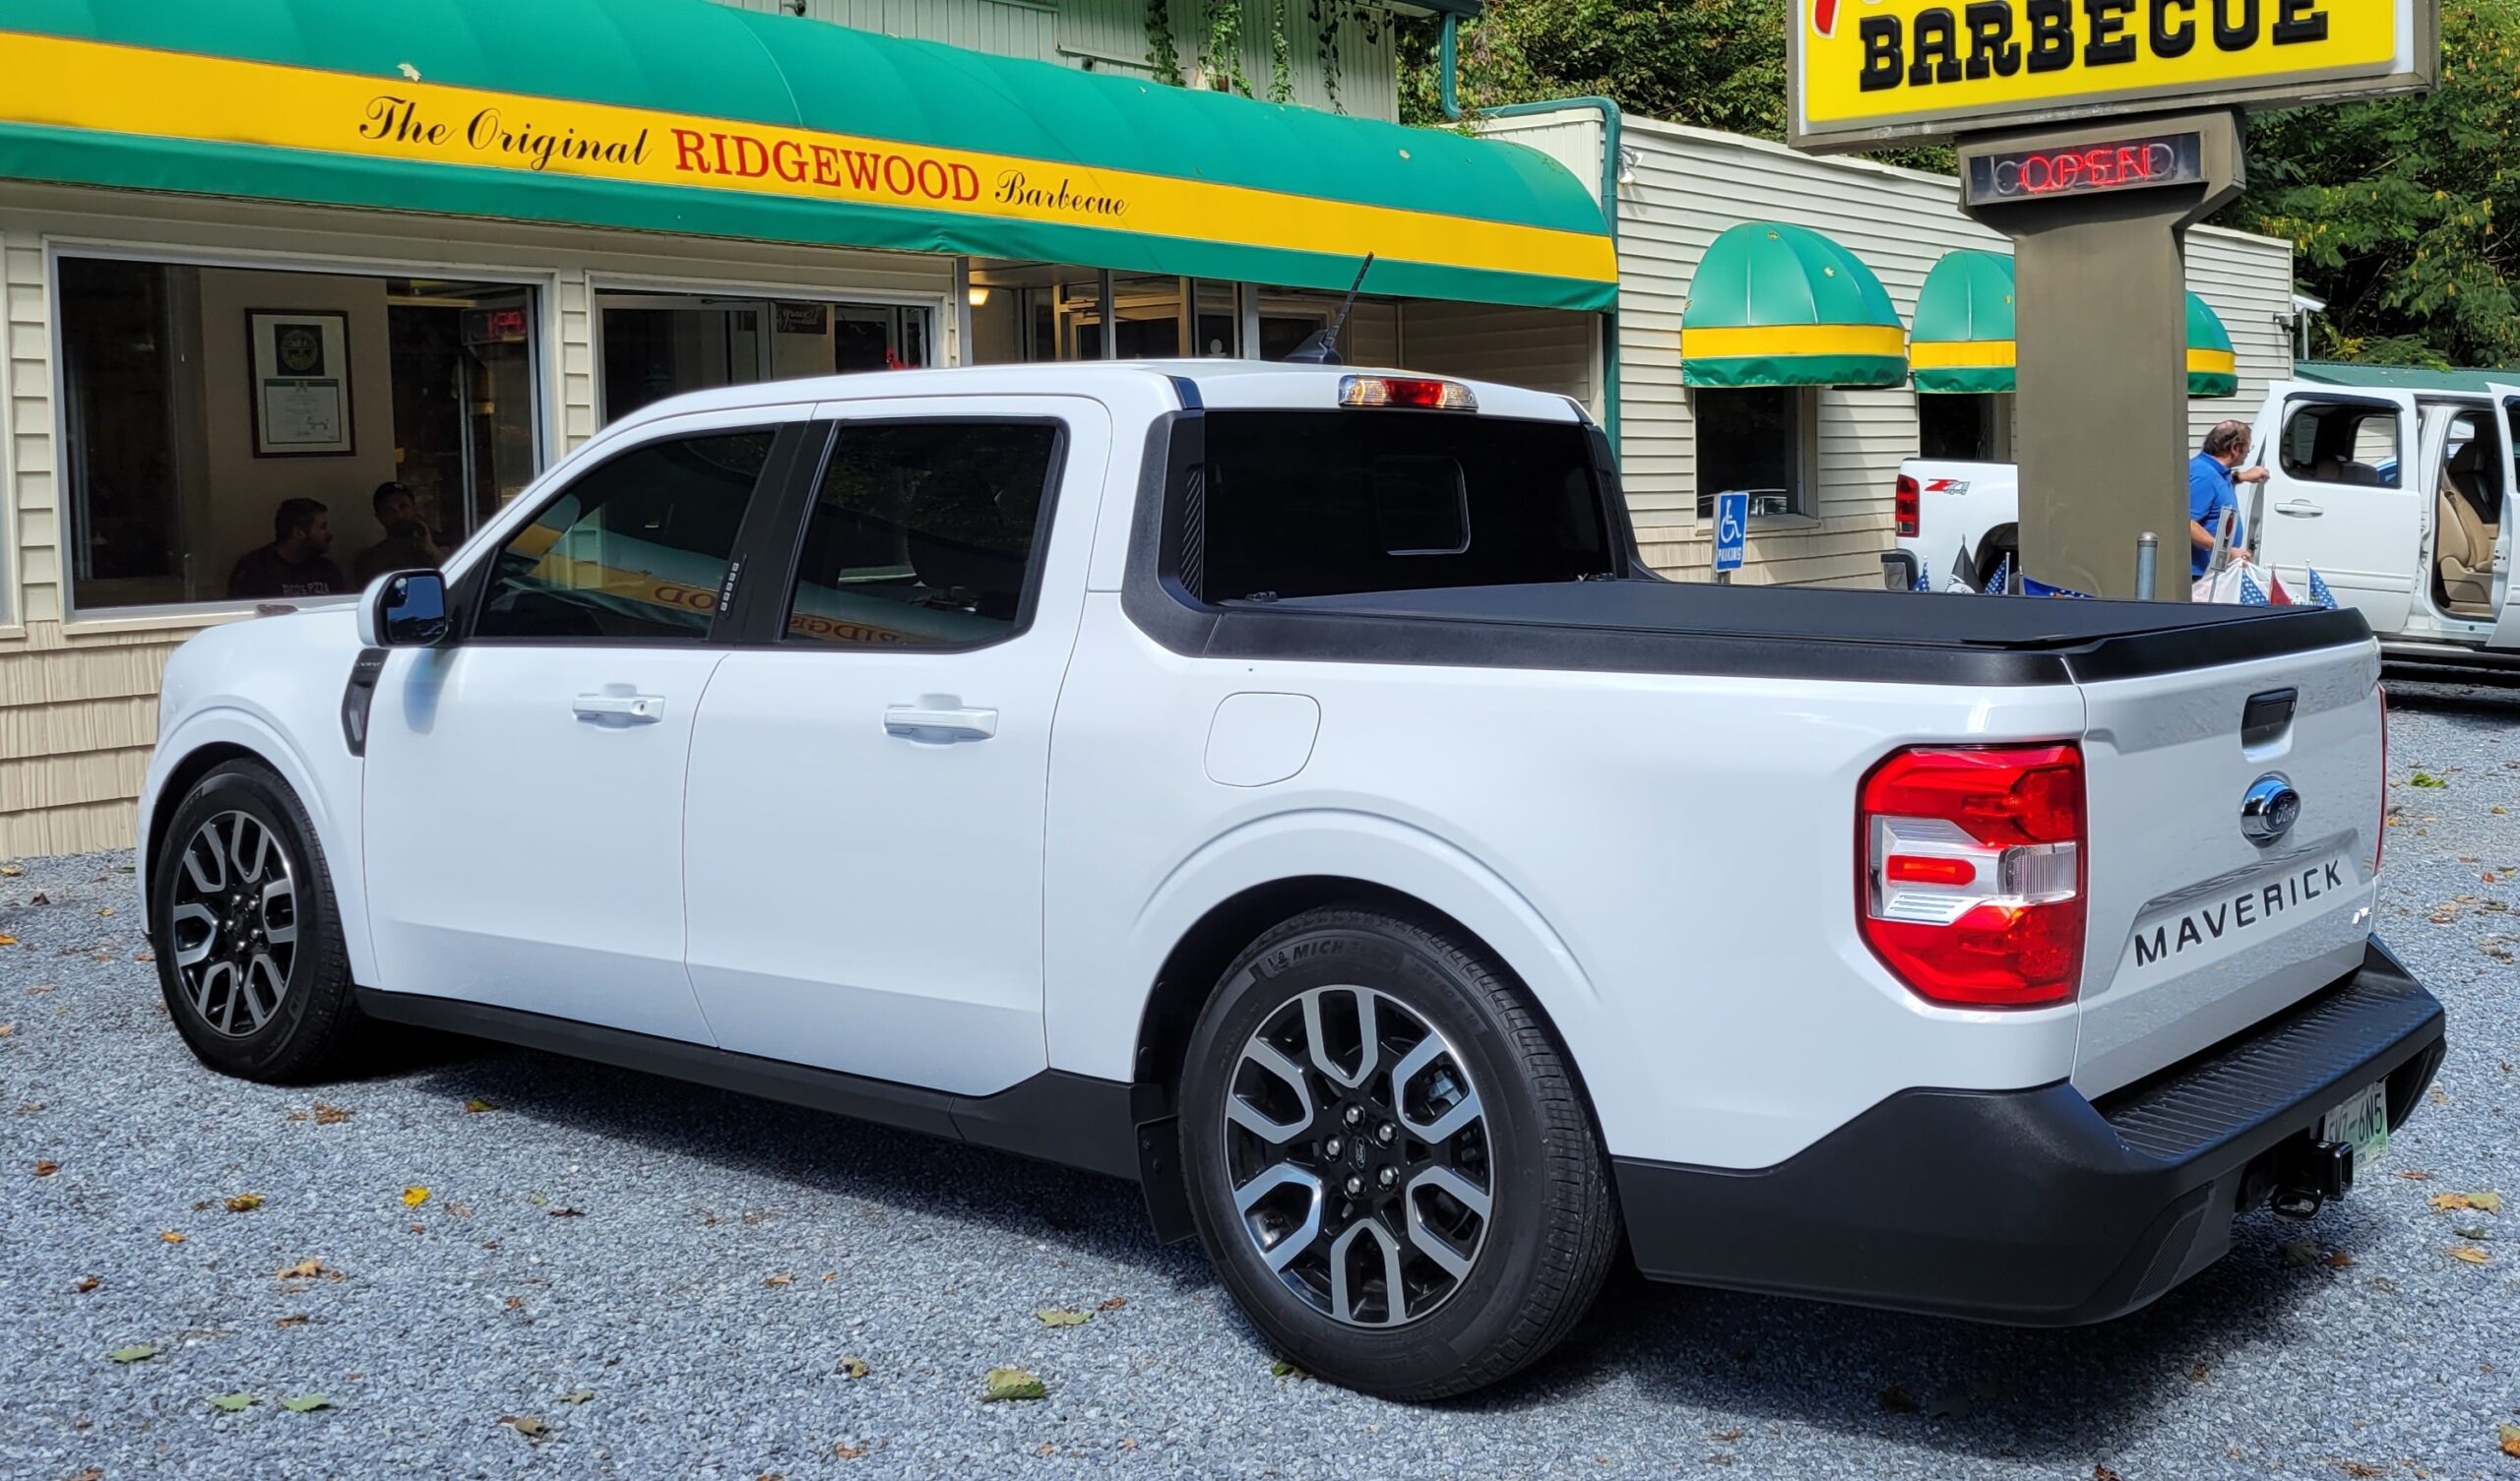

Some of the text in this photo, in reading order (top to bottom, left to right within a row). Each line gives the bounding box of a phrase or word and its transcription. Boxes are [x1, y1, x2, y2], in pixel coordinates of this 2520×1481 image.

[359, 94, 1131, 217] The Original RIDGEWOOD Barbecue
[2020, 143, 2150, 194] OPEN
[2134, 859, 2343, 968] MAVERICK
